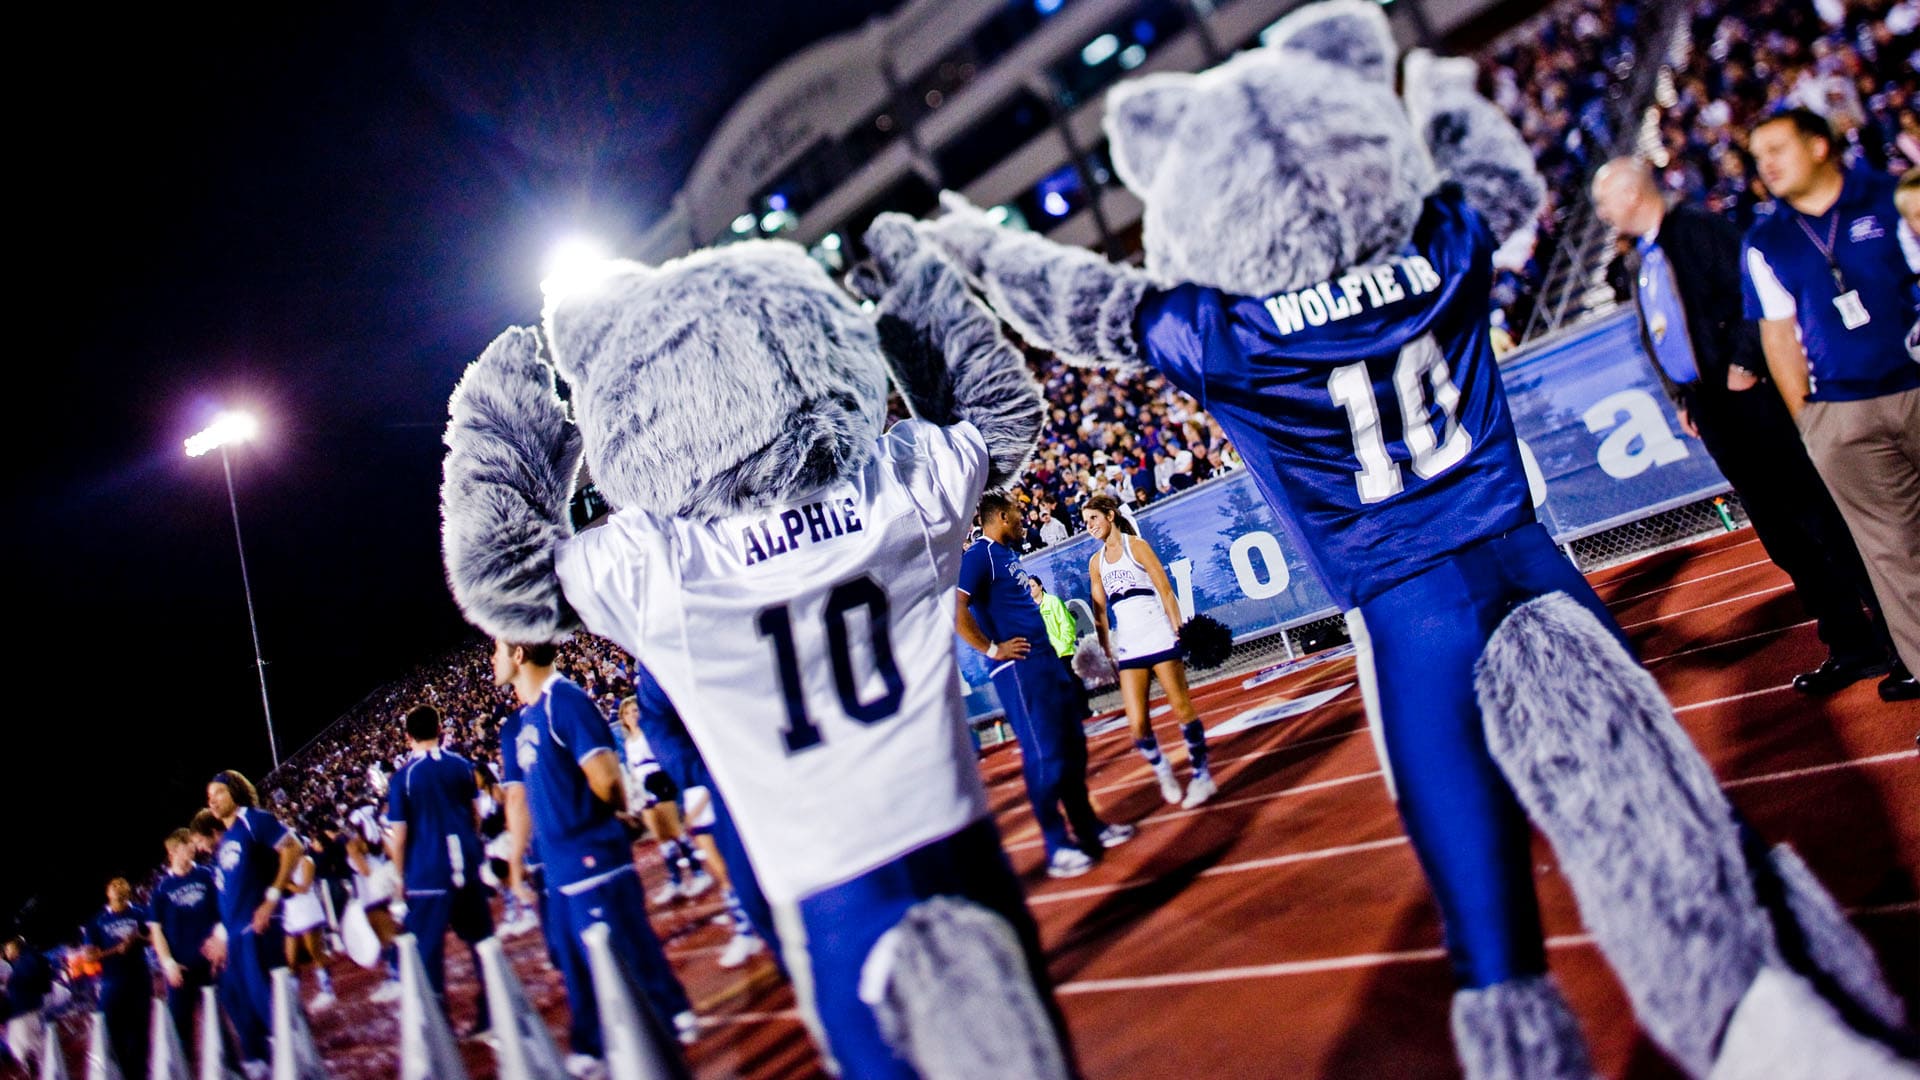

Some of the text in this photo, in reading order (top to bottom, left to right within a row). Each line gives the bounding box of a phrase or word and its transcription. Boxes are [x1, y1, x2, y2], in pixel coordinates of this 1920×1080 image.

[1264, 264, 1405, 335] WOLFIE
[1327, 330, 1473, 504] 10
[741, 497, 863, 566] ALPHIE
[755, 573, 905, 757] 10
